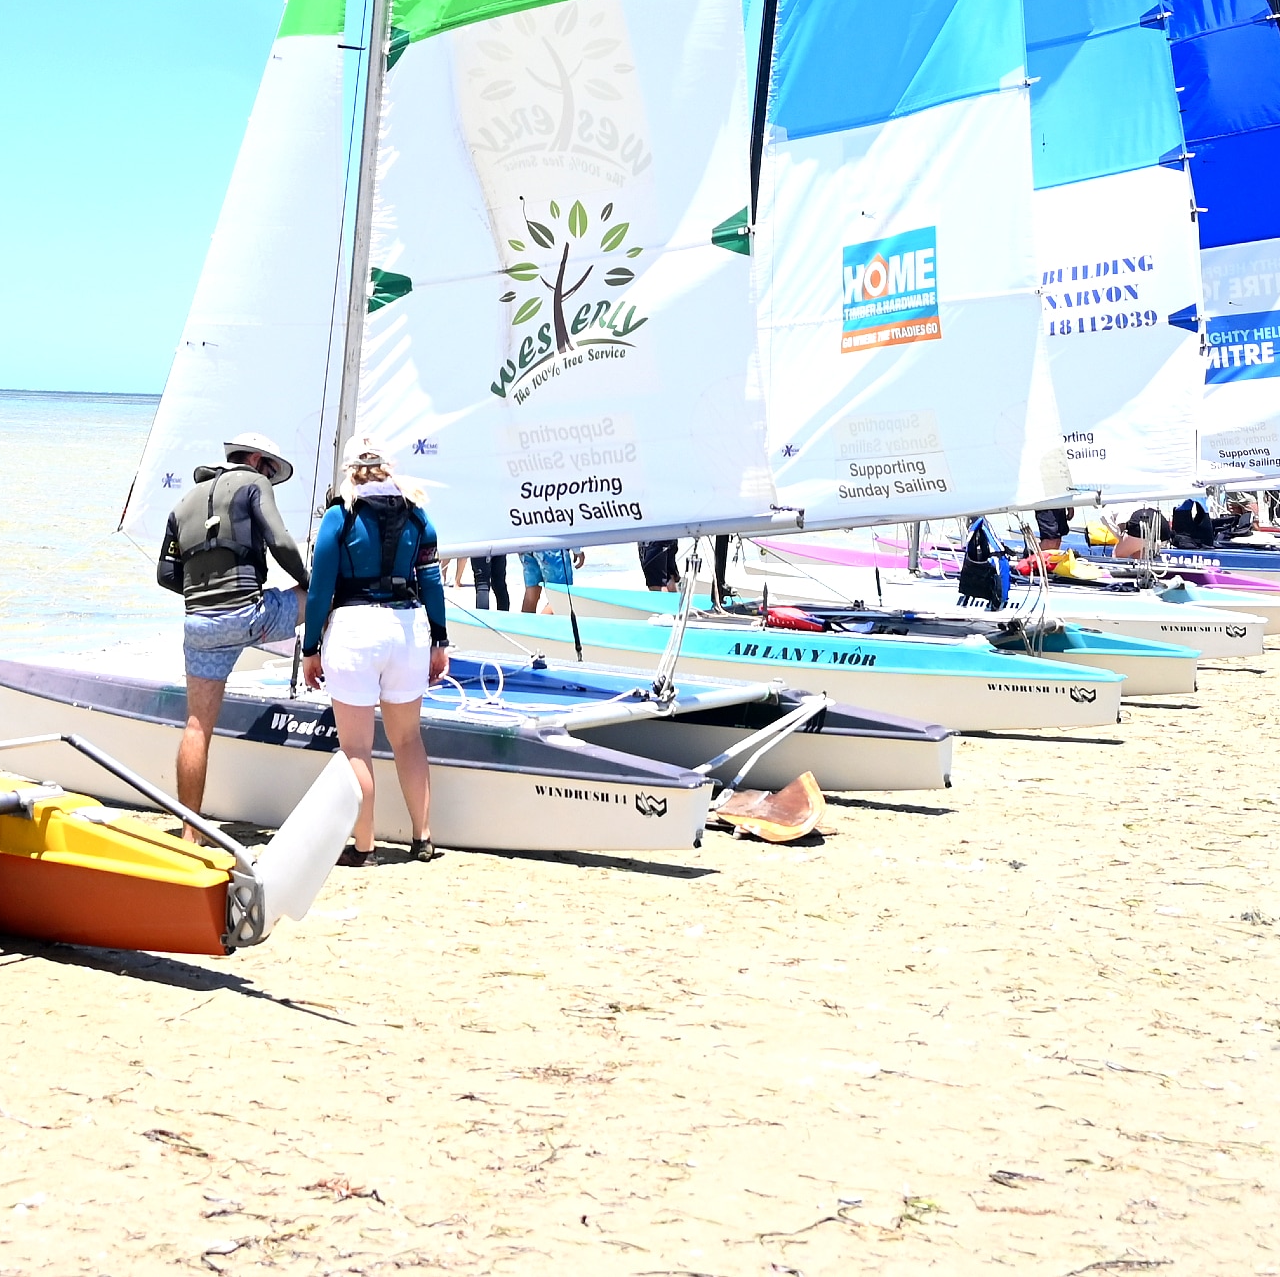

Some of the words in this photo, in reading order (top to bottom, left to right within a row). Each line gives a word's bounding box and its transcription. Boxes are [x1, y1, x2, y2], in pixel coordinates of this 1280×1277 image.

[843, 248, 935, 305] HOME
[890, 324, 926, 339] TRADIES
[926, 323, 938, 334] GO
[1206, 341, 1275, 370] MITRE
[513, 387, 531, 406] The
[532, 363, 561, 390] 100%
[563, 355, 583, 371] Tree
[588, 346, 626, 362] Service
[1066, 447, 1106, 460] Sailing
[1219, 447, 1271, 459] Supporting
[849, 459, 927, 480] Supporting
[520, 475, 623, 502] Supporting
[838, 484, 890, 499] Sunday
[893, 478, 947, 495] Sailing
[509, 506, 574, 526] Sunday
[578, 500, 642, 520] Sailing
[987, 683, 1050, 693] WINDRUSH
[271, 712, 339, 739] Wester
[535, 785, 610, 803] WINDRUSH
